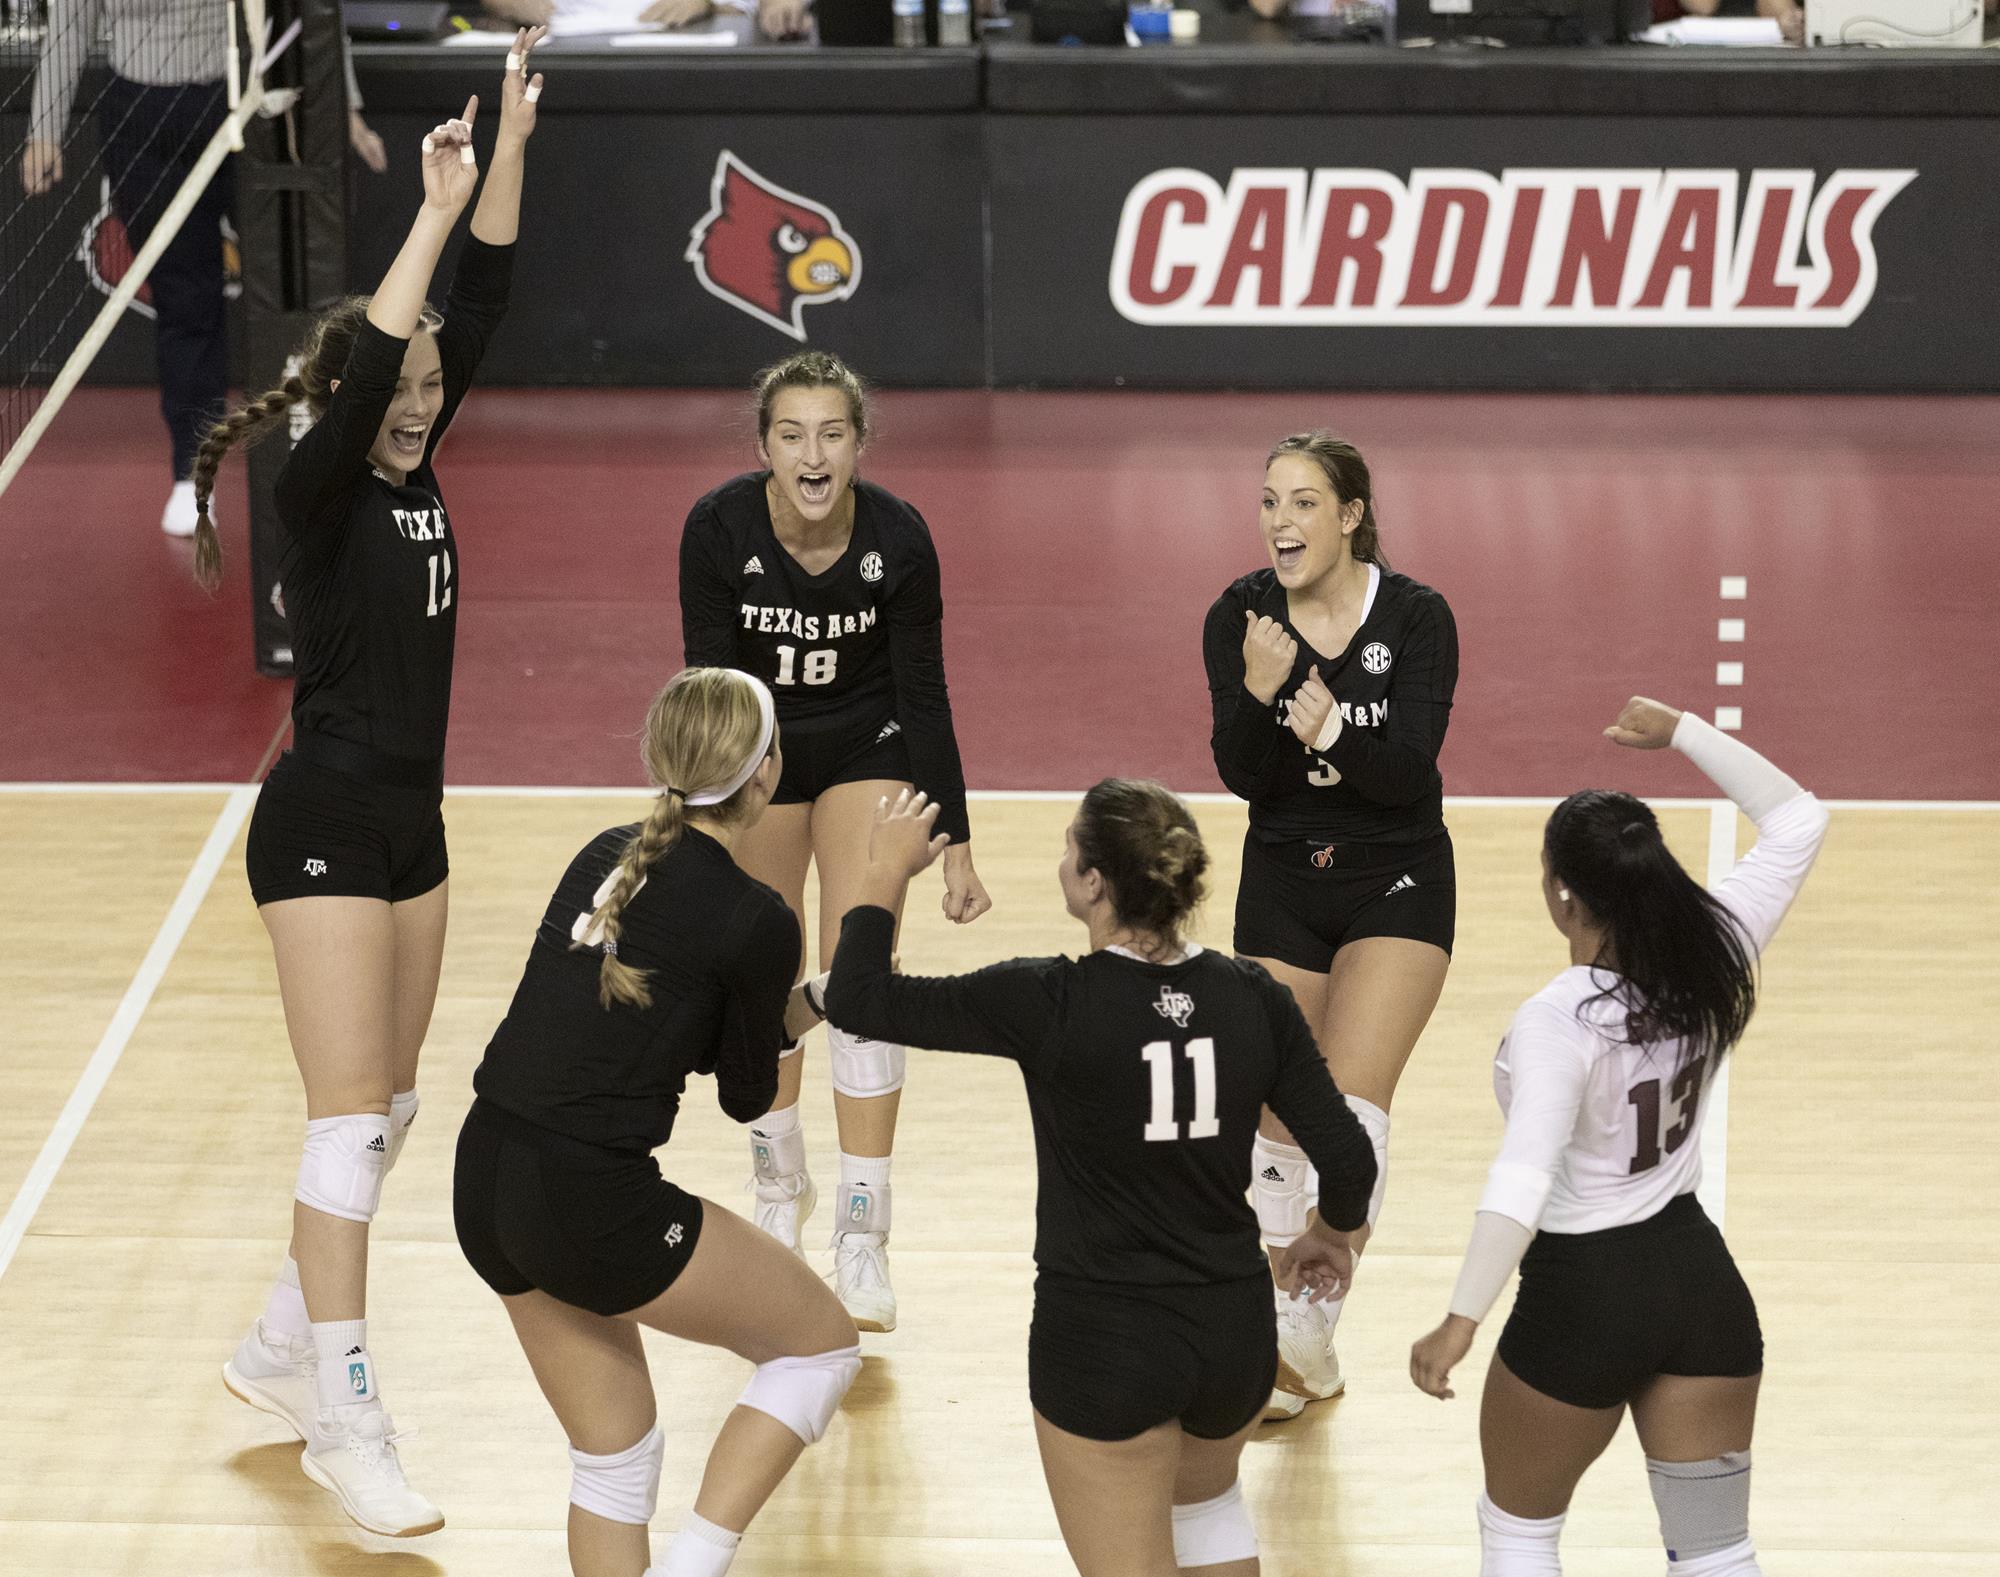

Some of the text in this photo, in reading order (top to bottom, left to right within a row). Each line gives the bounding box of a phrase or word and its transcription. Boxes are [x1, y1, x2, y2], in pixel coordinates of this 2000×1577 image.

[1118, 177, 1898, 318] CARDINALS
[861, 553, 884, 581] SEC
[741, 603, 876, 641] TEXAS A&M
[775, 645, 838, 686] 18
[1362, 643, 1391, 673] SEC
[1141, 1037, 1220, 1142] 11
[1628, 1055, 1708, 1175] 13
